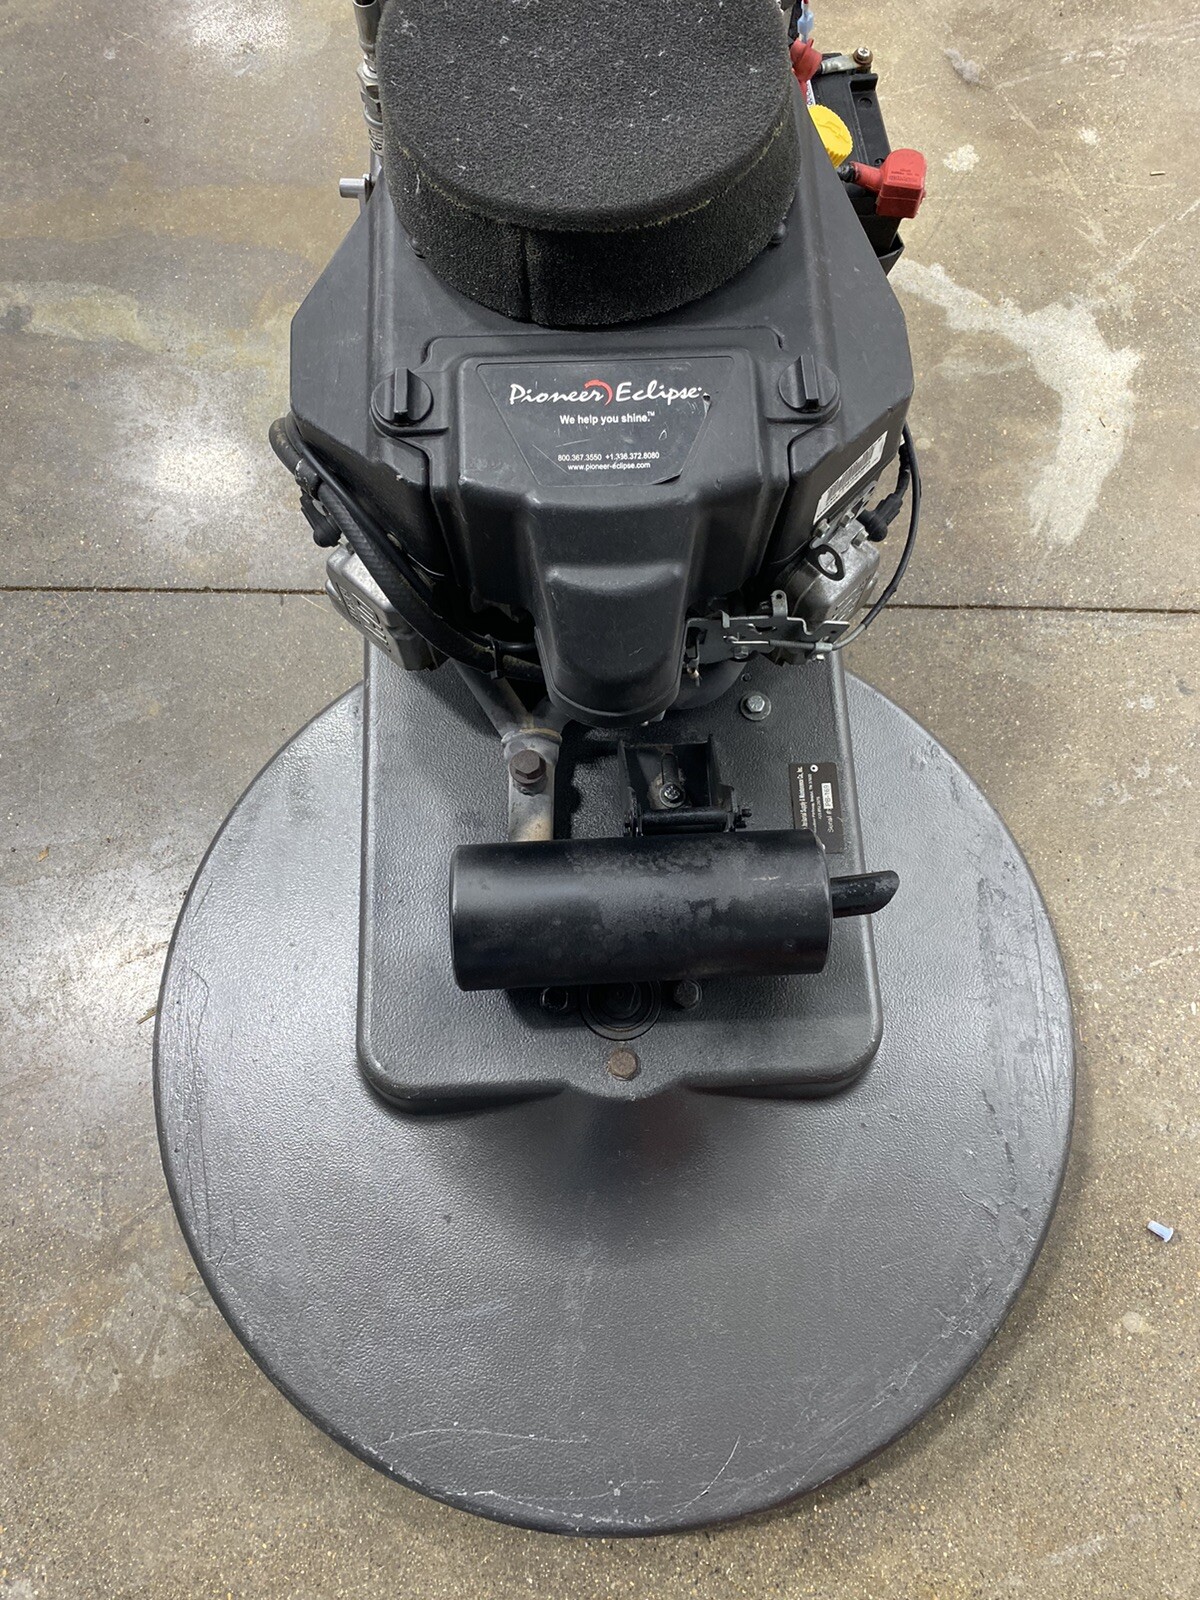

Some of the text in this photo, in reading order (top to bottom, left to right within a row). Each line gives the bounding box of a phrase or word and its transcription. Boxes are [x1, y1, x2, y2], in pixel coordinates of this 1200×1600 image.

[509, 383, 604, 405] Pioneer
[559, 415, 575, 425] We
[577, 413, 598, 426] help
[600, 415, 619, 426] you
[557, 453, 602, 462] 800.367.3550
[567, 461, 650, 472] www.pioneer-eclipse.com
